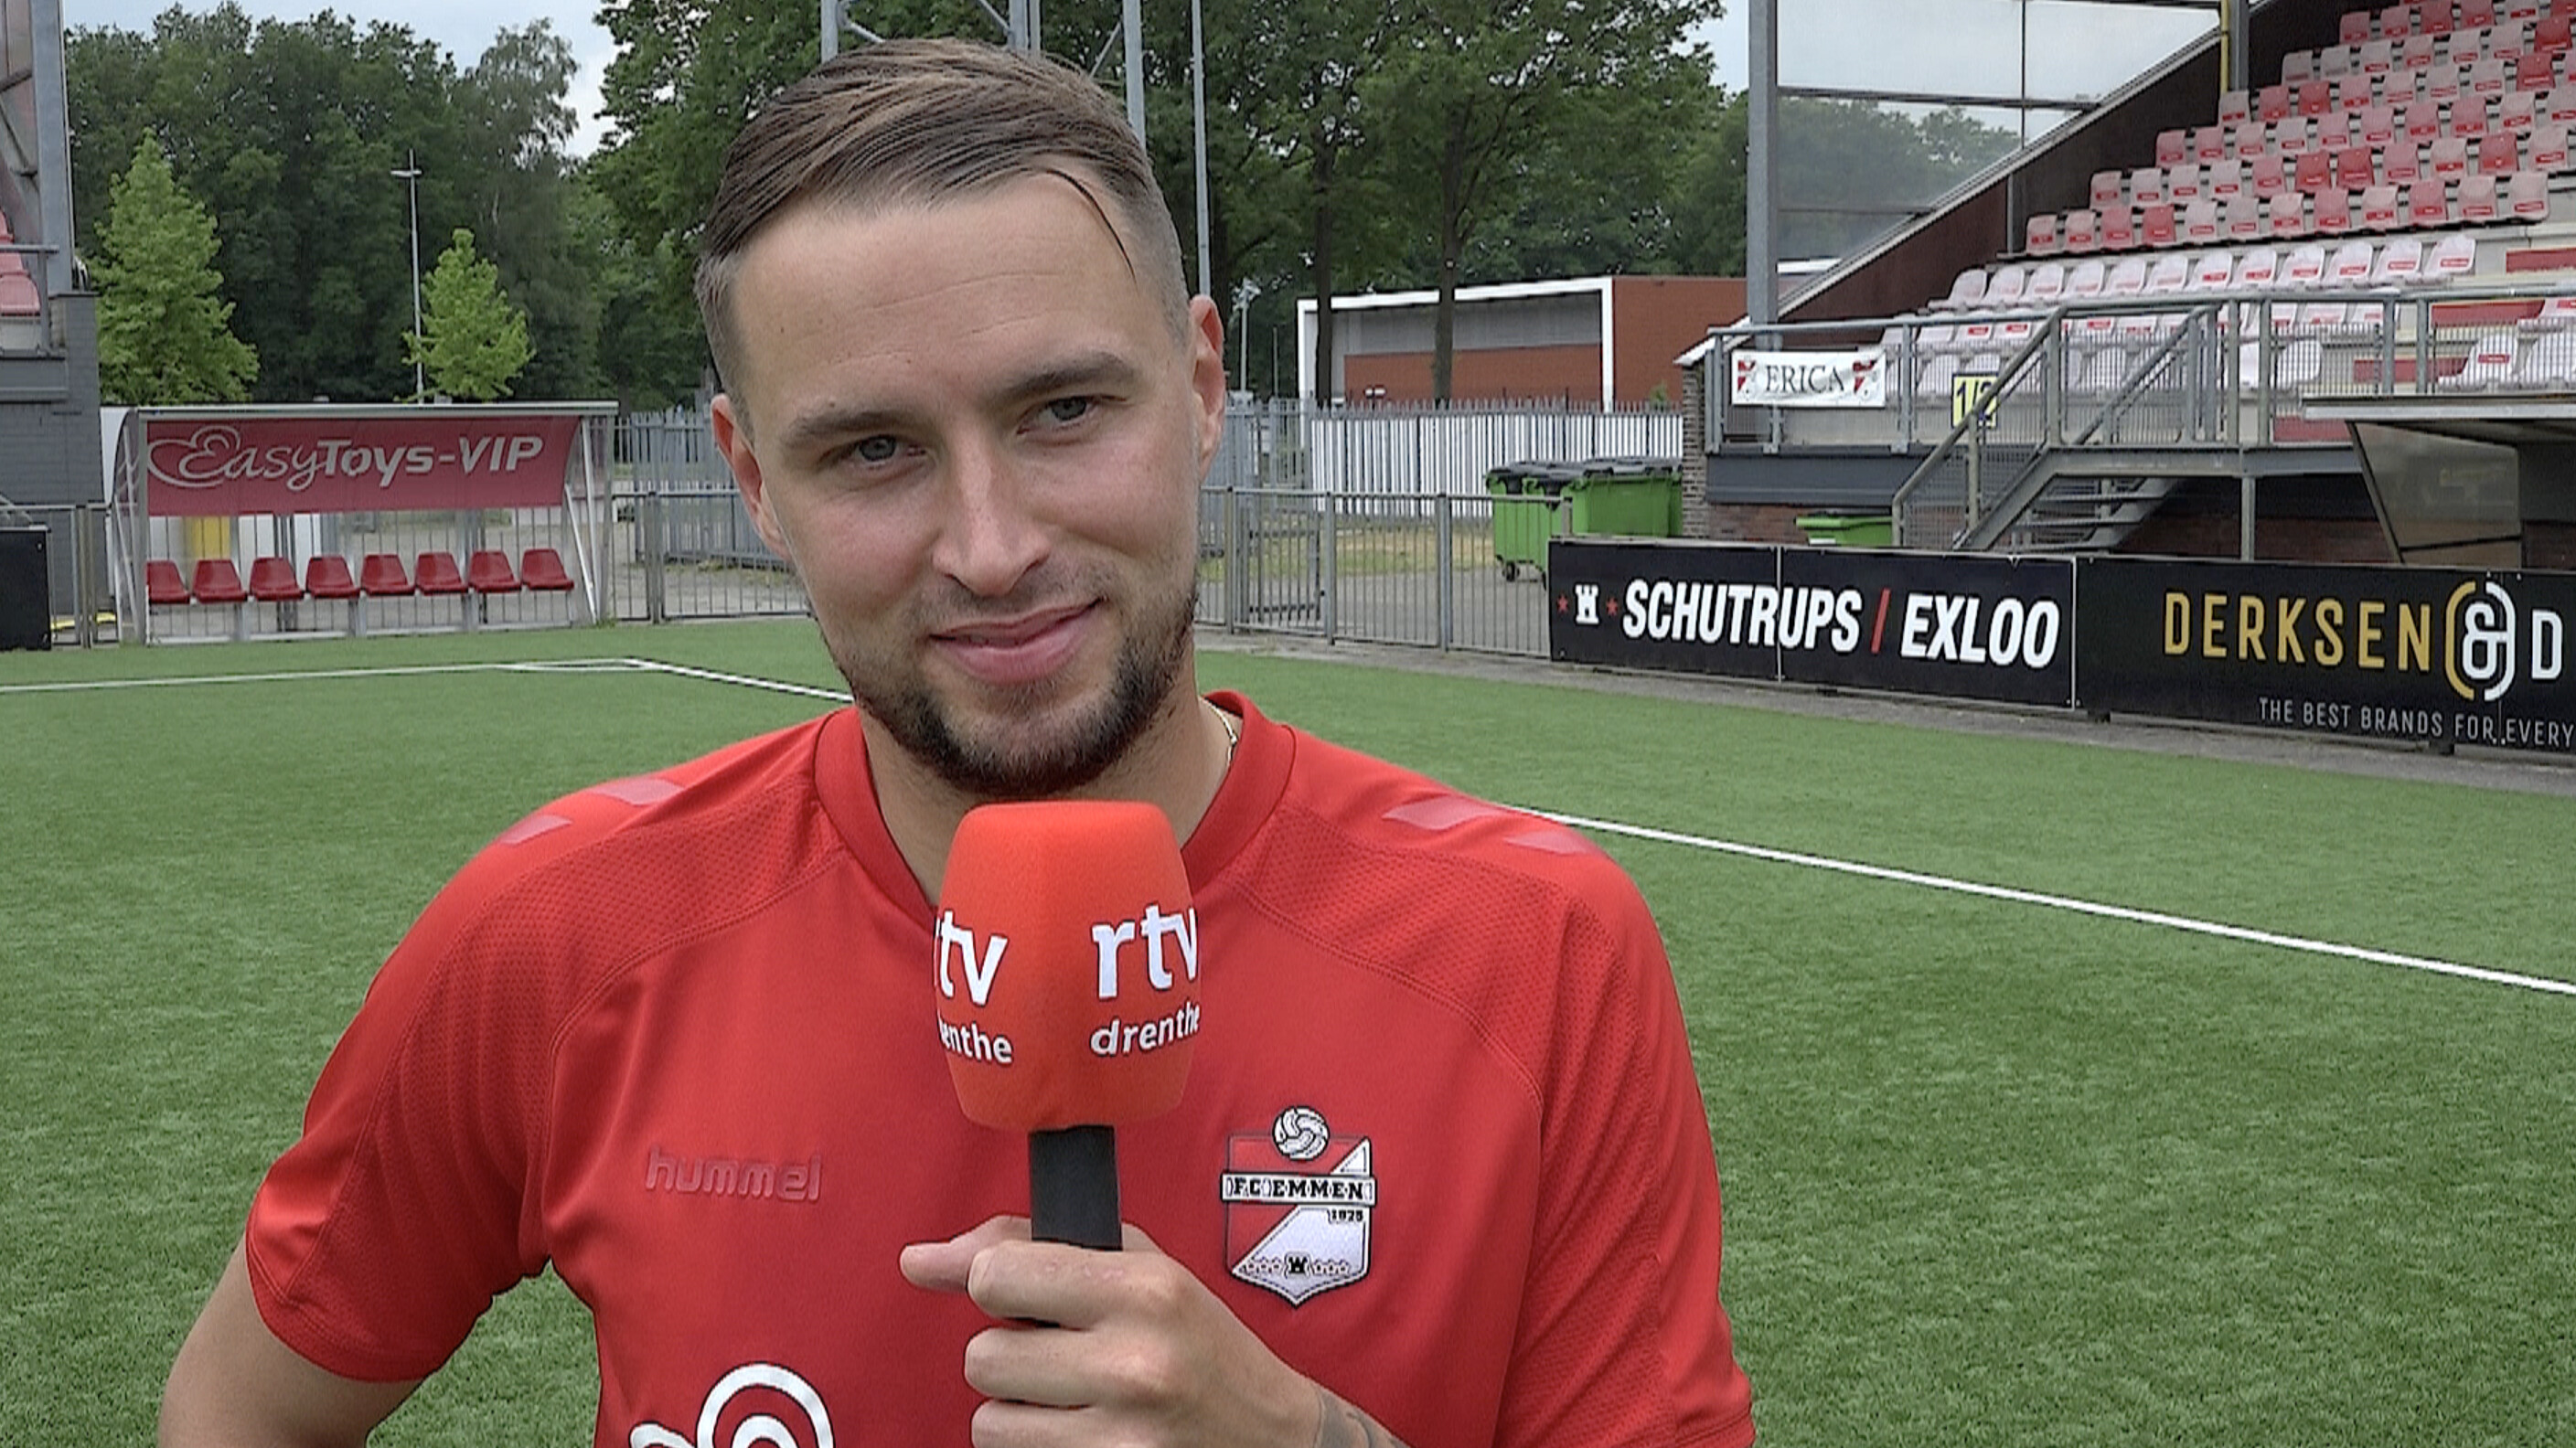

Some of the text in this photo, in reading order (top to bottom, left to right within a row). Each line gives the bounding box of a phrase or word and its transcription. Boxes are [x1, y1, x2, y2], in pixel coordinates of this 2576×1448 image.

[1765, 364, 1845, 393] ERICA
[1622, 580, 1863, 653] SCHUTRUPS
[1900, 593, 2060, 669] EXLOO
[2164, 591, 2431, 672] DERKSEN
[2531, 609, 2563, 679] D
[2259, 697, 2575, 749] THE BEST BRANDS FOR EVERY
[934, 910, 1009, 1006] tv
[1091, 904, 1198, 999] rtv
[1090, 1001, 1200, 1056] drenthe
[645, 1145, 822, 1201] hummel
[1272, 1179, 1363, 1200] EMMEN
